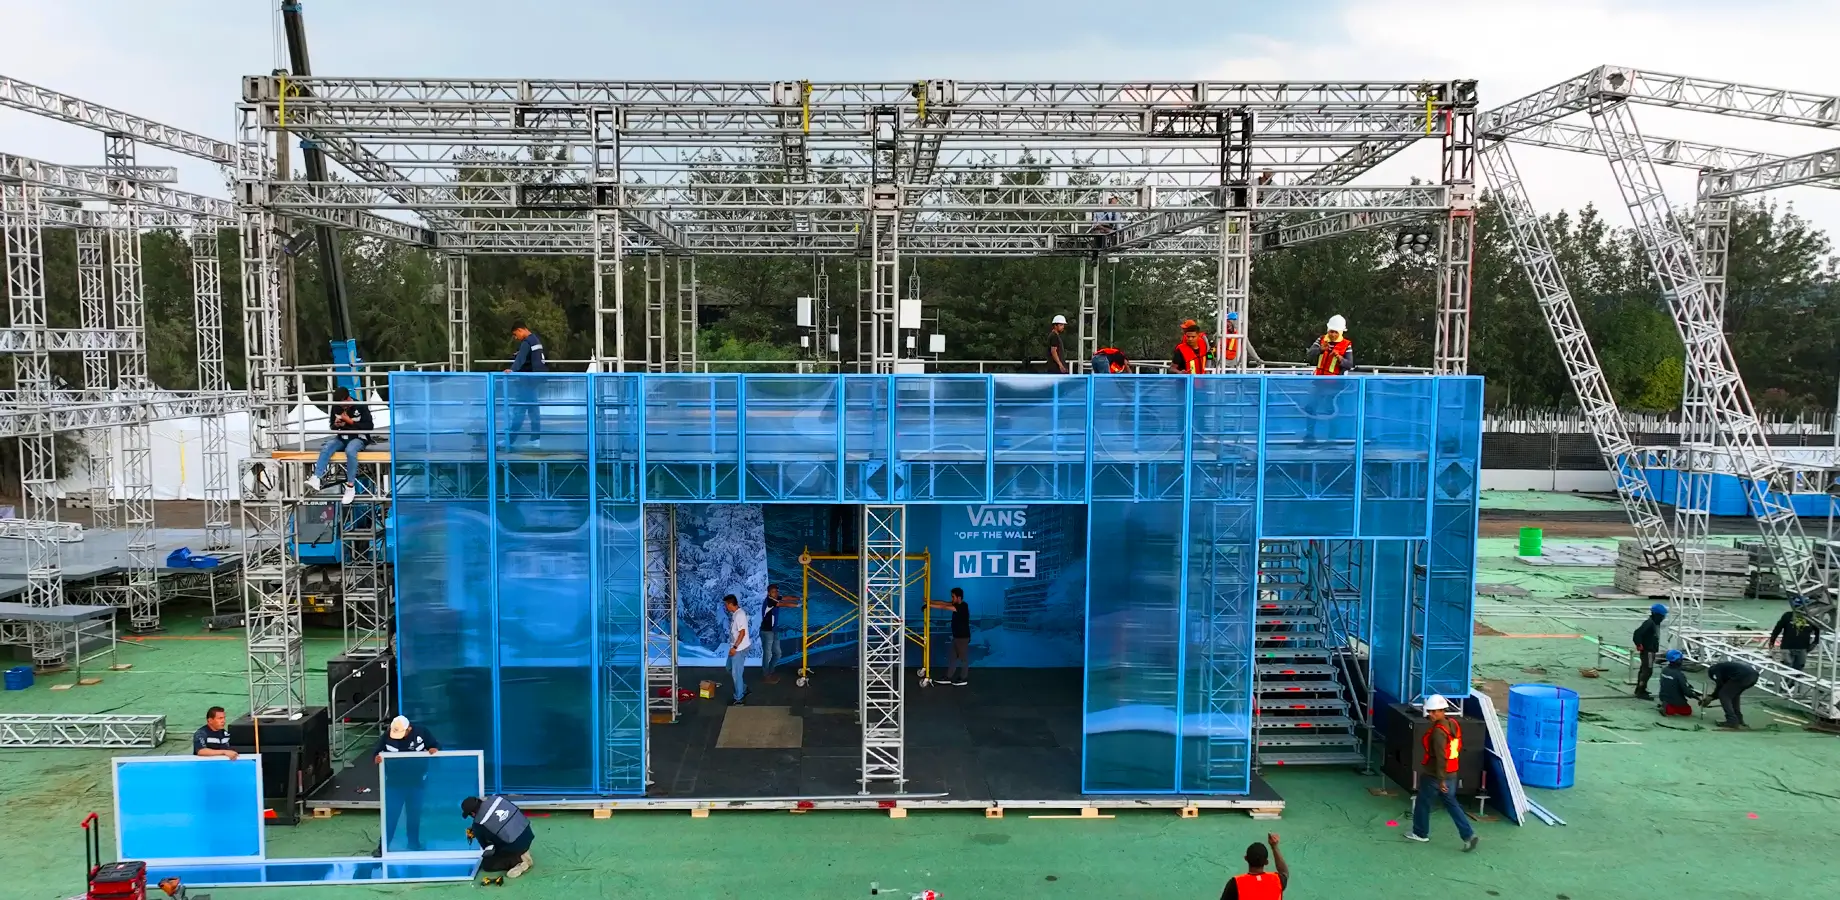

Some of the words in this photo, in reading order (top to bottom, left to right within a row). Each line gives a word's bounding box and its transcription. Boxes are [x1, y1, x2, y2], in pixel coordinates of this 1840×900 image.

[966, 505, 1028, 527] VANS
[982, 531, 1003, 539] THE
[956, 552, 1034, 576] MTE
